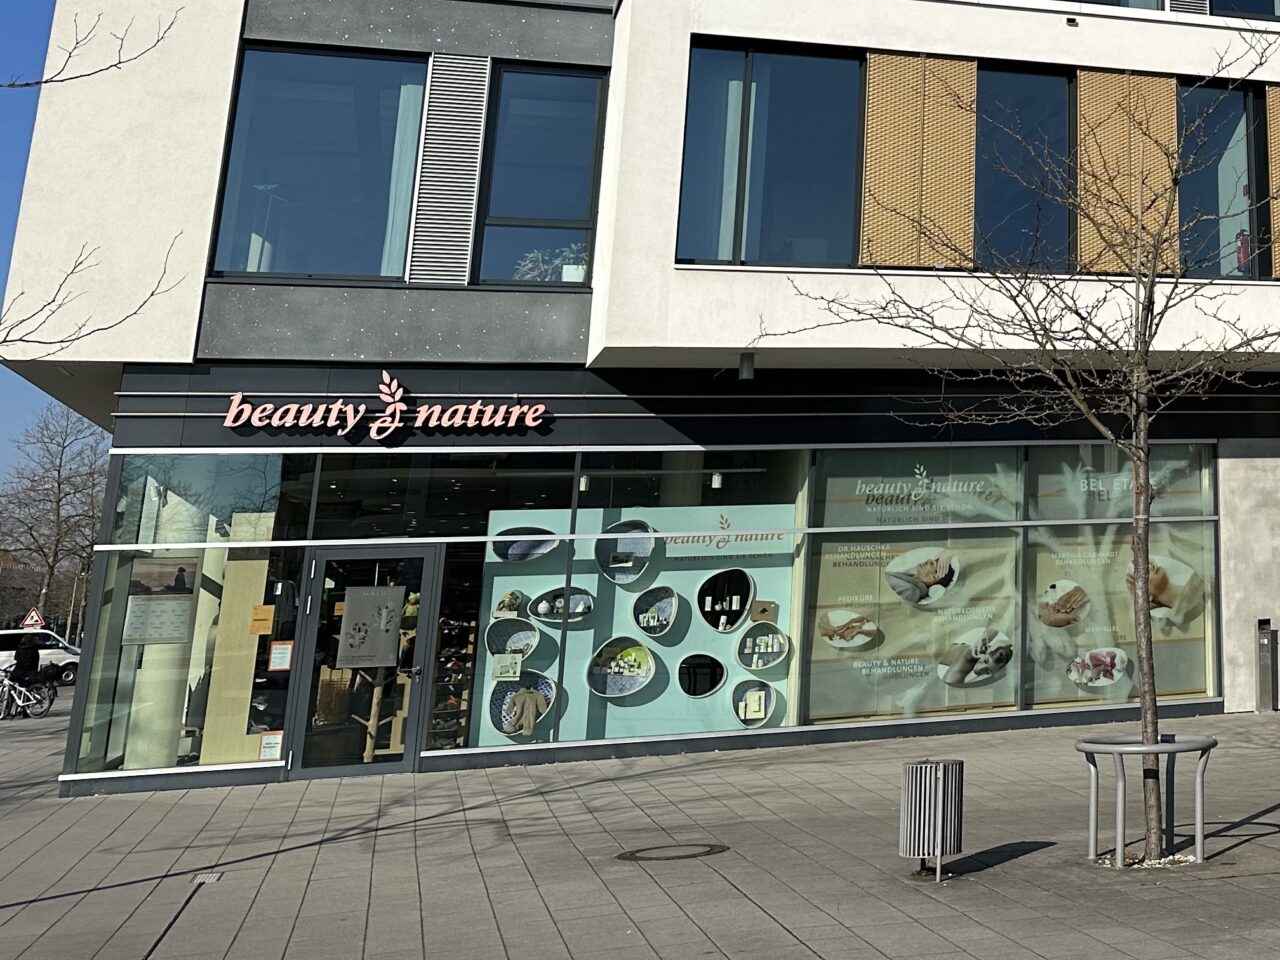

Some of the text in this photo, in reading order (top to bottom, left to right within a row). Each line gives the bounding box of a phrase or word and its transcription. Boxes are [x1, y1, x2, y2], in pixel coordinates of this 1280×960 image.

[223, 391, 366, 436] beauty
[414, 399, 546, 428] nature
[855, 480, 912, 497] beauty
[931, 480, 985, 493] nature
[1080, 478, 1106, 491] BEL
[663, 535, 716, 547] beauty
[824, 552, 888, 560] BEHANDLUNGEN
[853, 660, 882, 669] BEAUTY
[890, 657, 920, 666] NATURE
[861, 664, 924, 675] BEHANDLUNGEN
